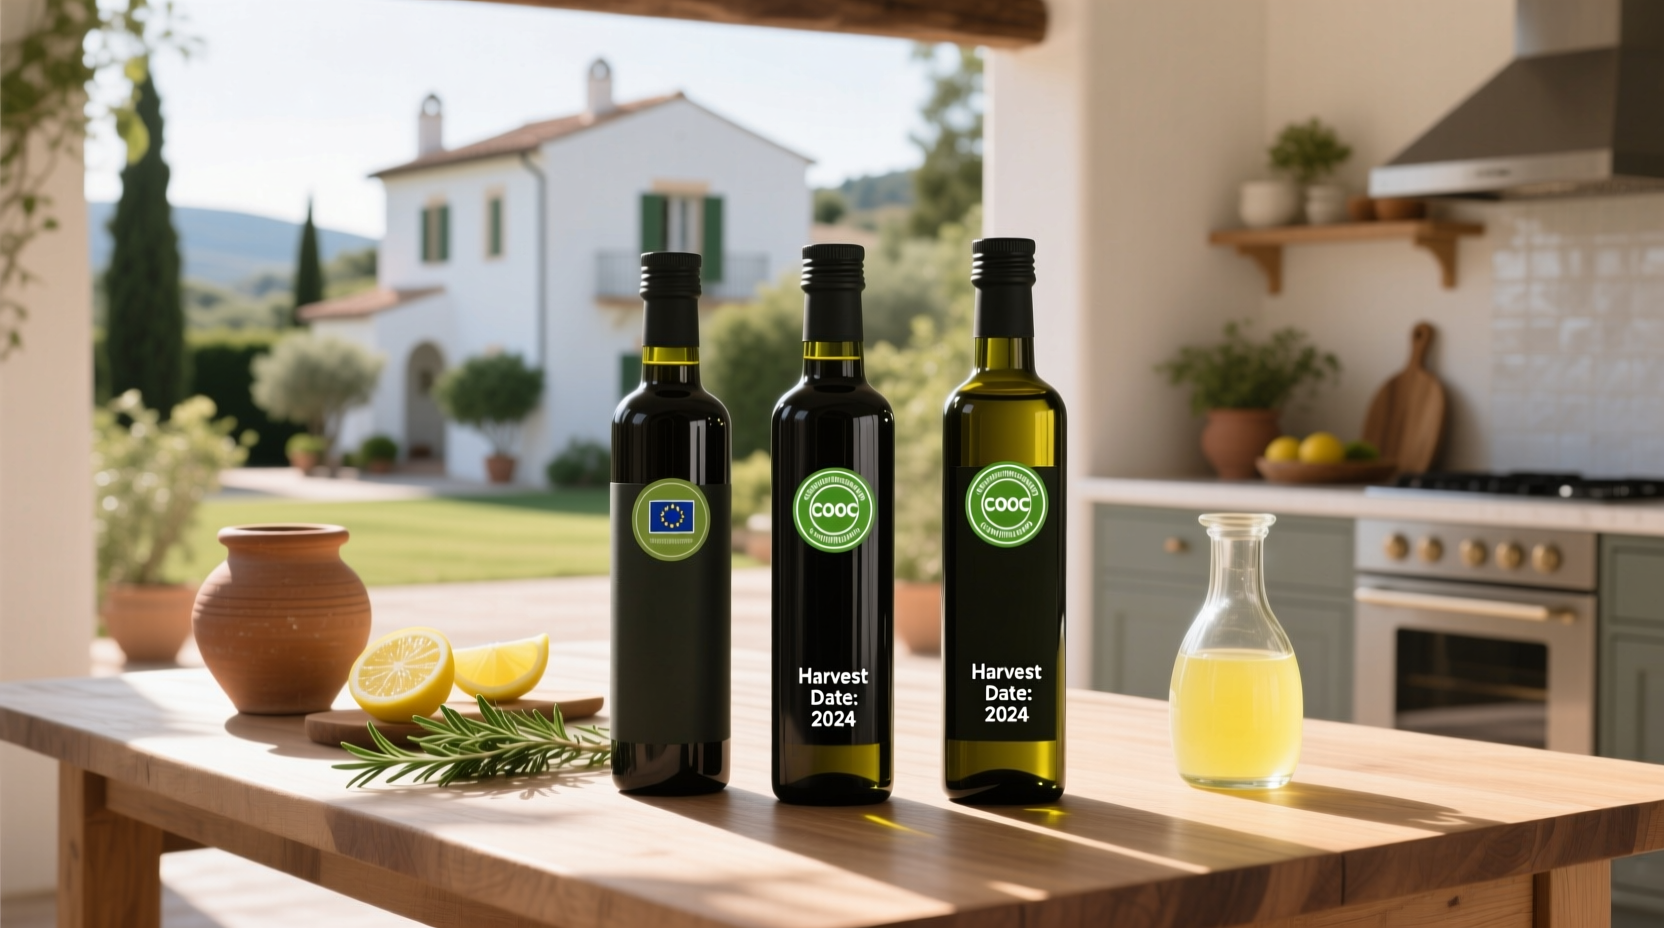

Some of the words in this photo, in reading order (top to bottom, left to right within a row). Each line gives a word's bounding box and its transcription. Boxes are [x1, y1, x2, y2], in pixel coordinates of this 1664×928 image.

[811, 502, 859, 518] COOC
[984, 496, 1031, 512] COOC
[798, 667, 869, 685] Harvest
[972, 663, 1042, 680] Harvest
[811, 689, 858, 706] Date:
[985, 684, 1032, 701] Date:
[811, 710, 857, 727] 2024
[984, 705, 1030, 722] 2024
